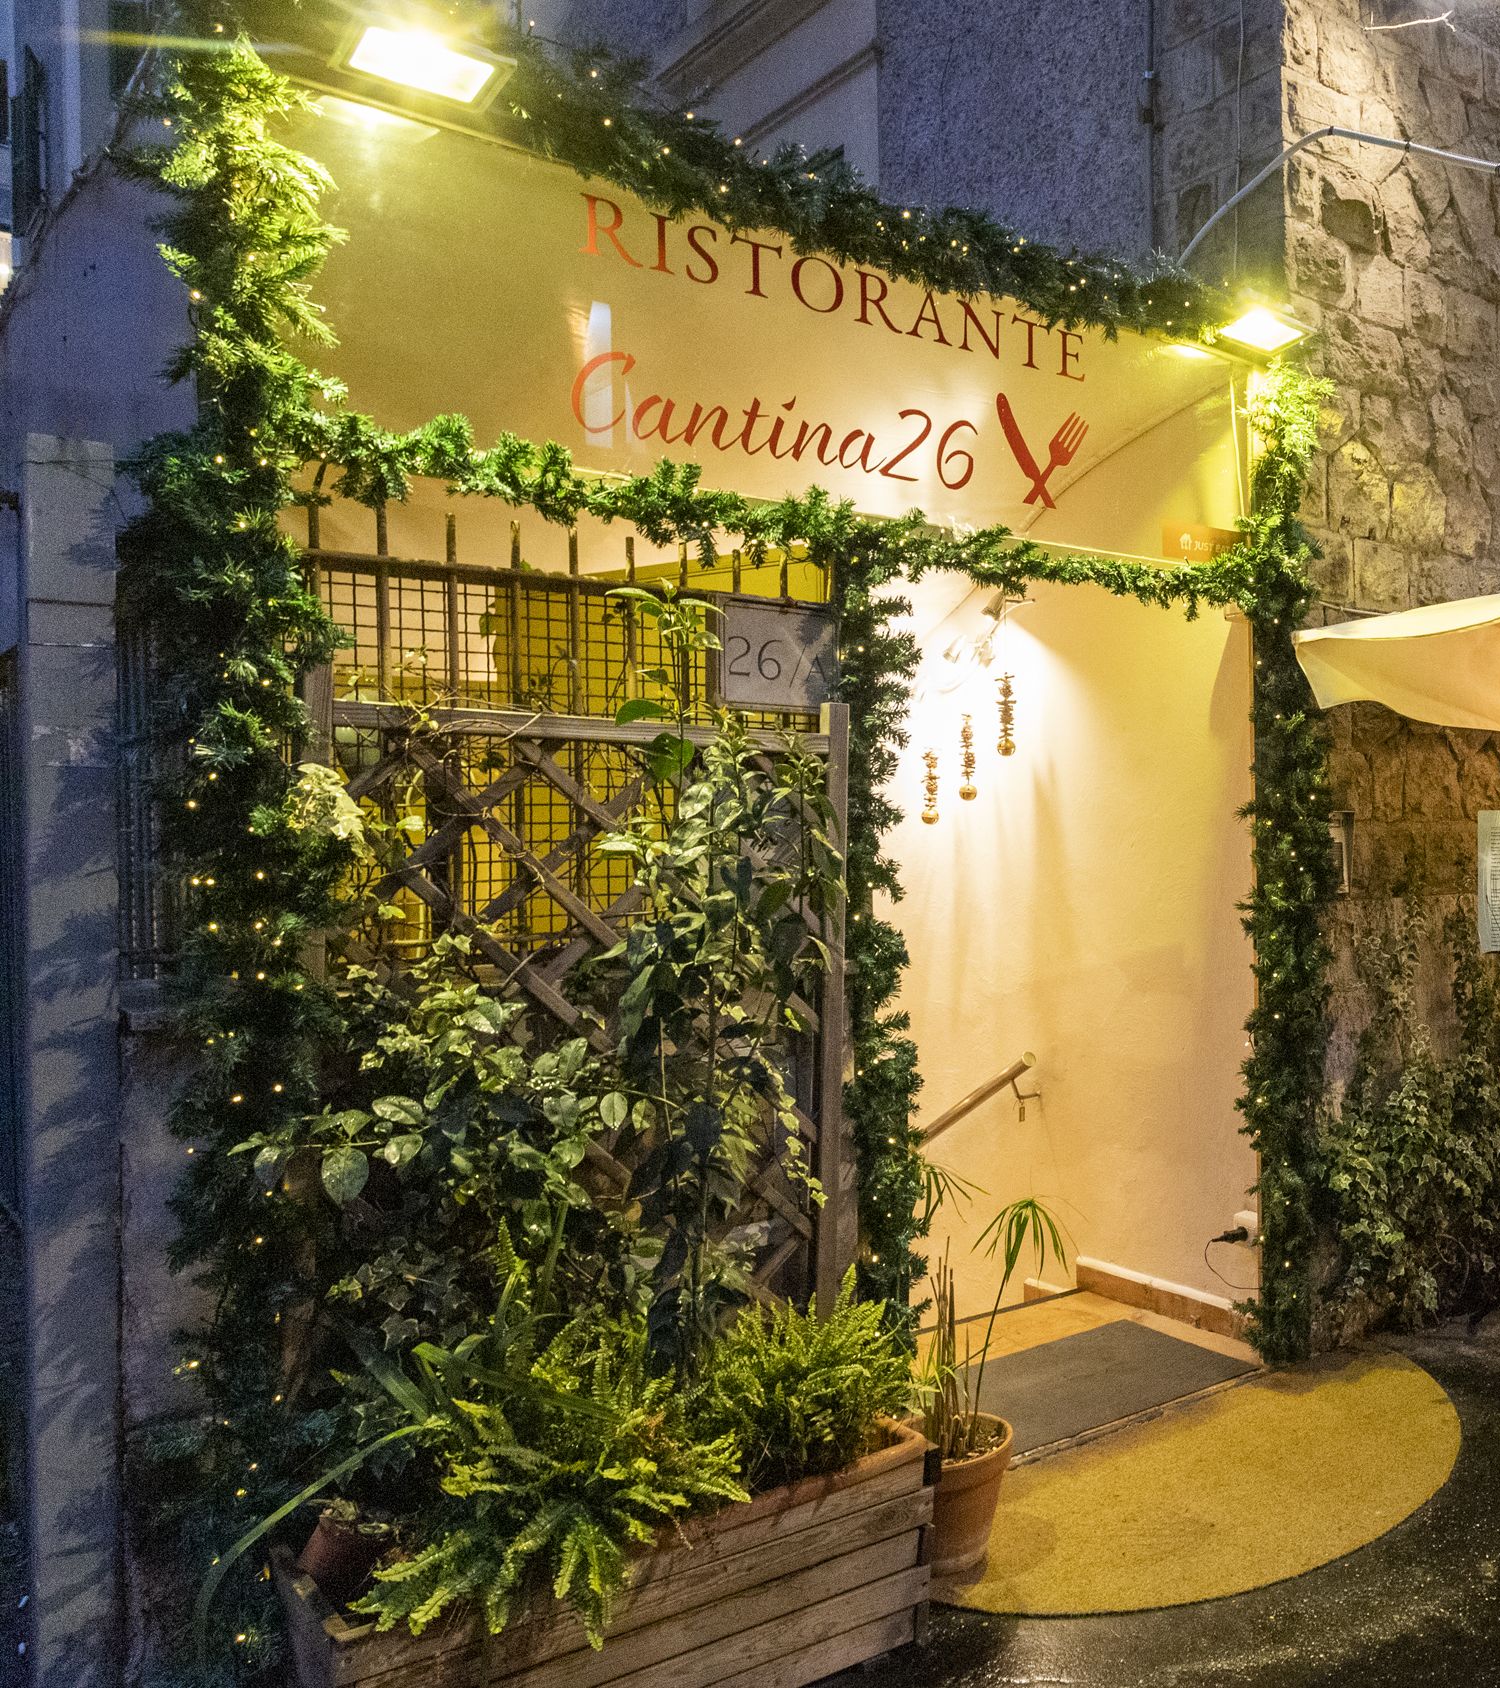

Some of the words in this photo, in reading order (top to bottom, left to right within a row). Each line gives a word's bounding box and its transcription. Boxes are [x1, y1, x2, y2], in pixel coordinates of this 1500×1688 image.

[579, 192, 1086, 382] RISTORANTE
[570, 351, 980, 490] Cantina26
[1194, 541, 1214, 552] JUST
[1216, 544, 1231, 553] EAT
[728, 635, 828, 689] 26/A
